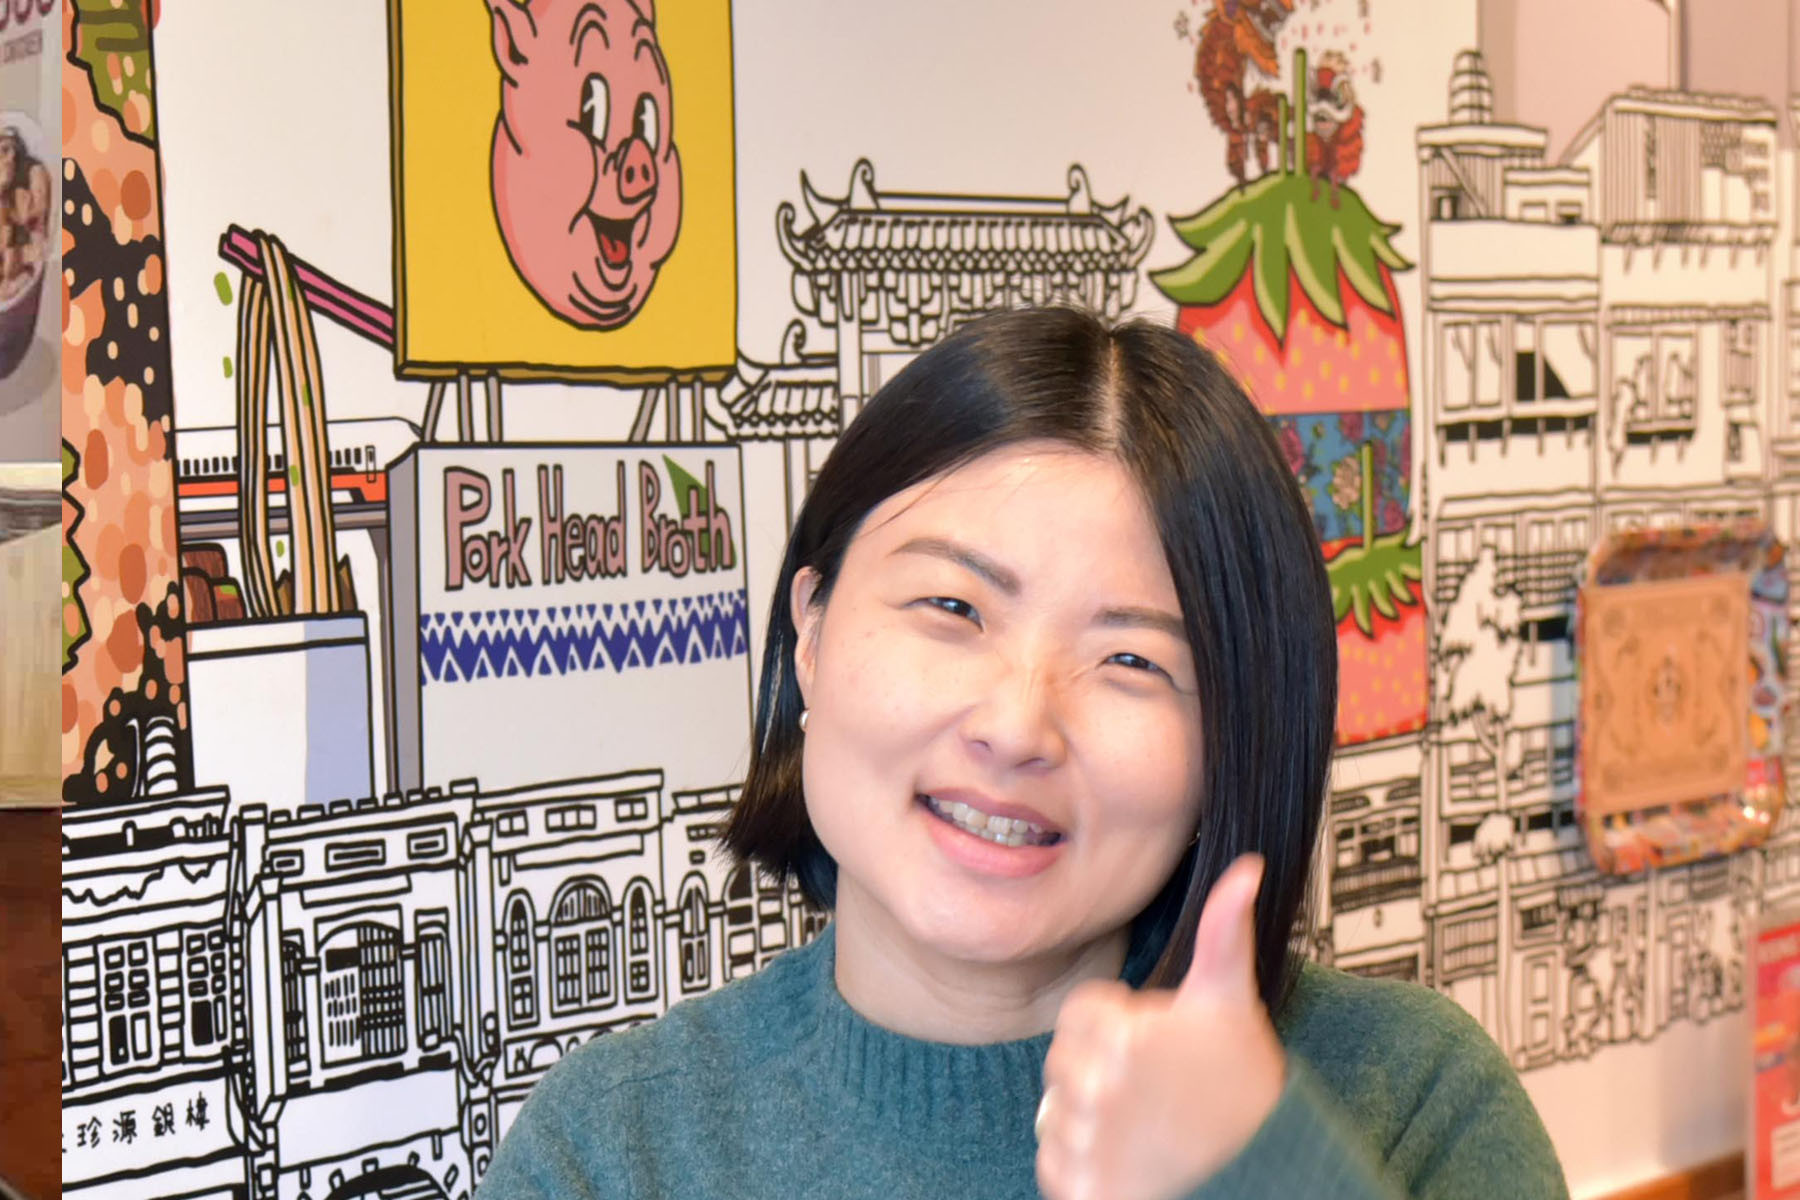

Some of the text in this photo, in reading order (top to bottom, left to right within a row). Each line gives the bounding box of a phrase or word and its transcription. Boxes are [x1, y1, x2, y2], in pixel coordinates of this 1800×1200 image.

[443, 459, 735, 592] Pork Head Broth
[62, 1090, 211, 1153] 珍源銀樓
